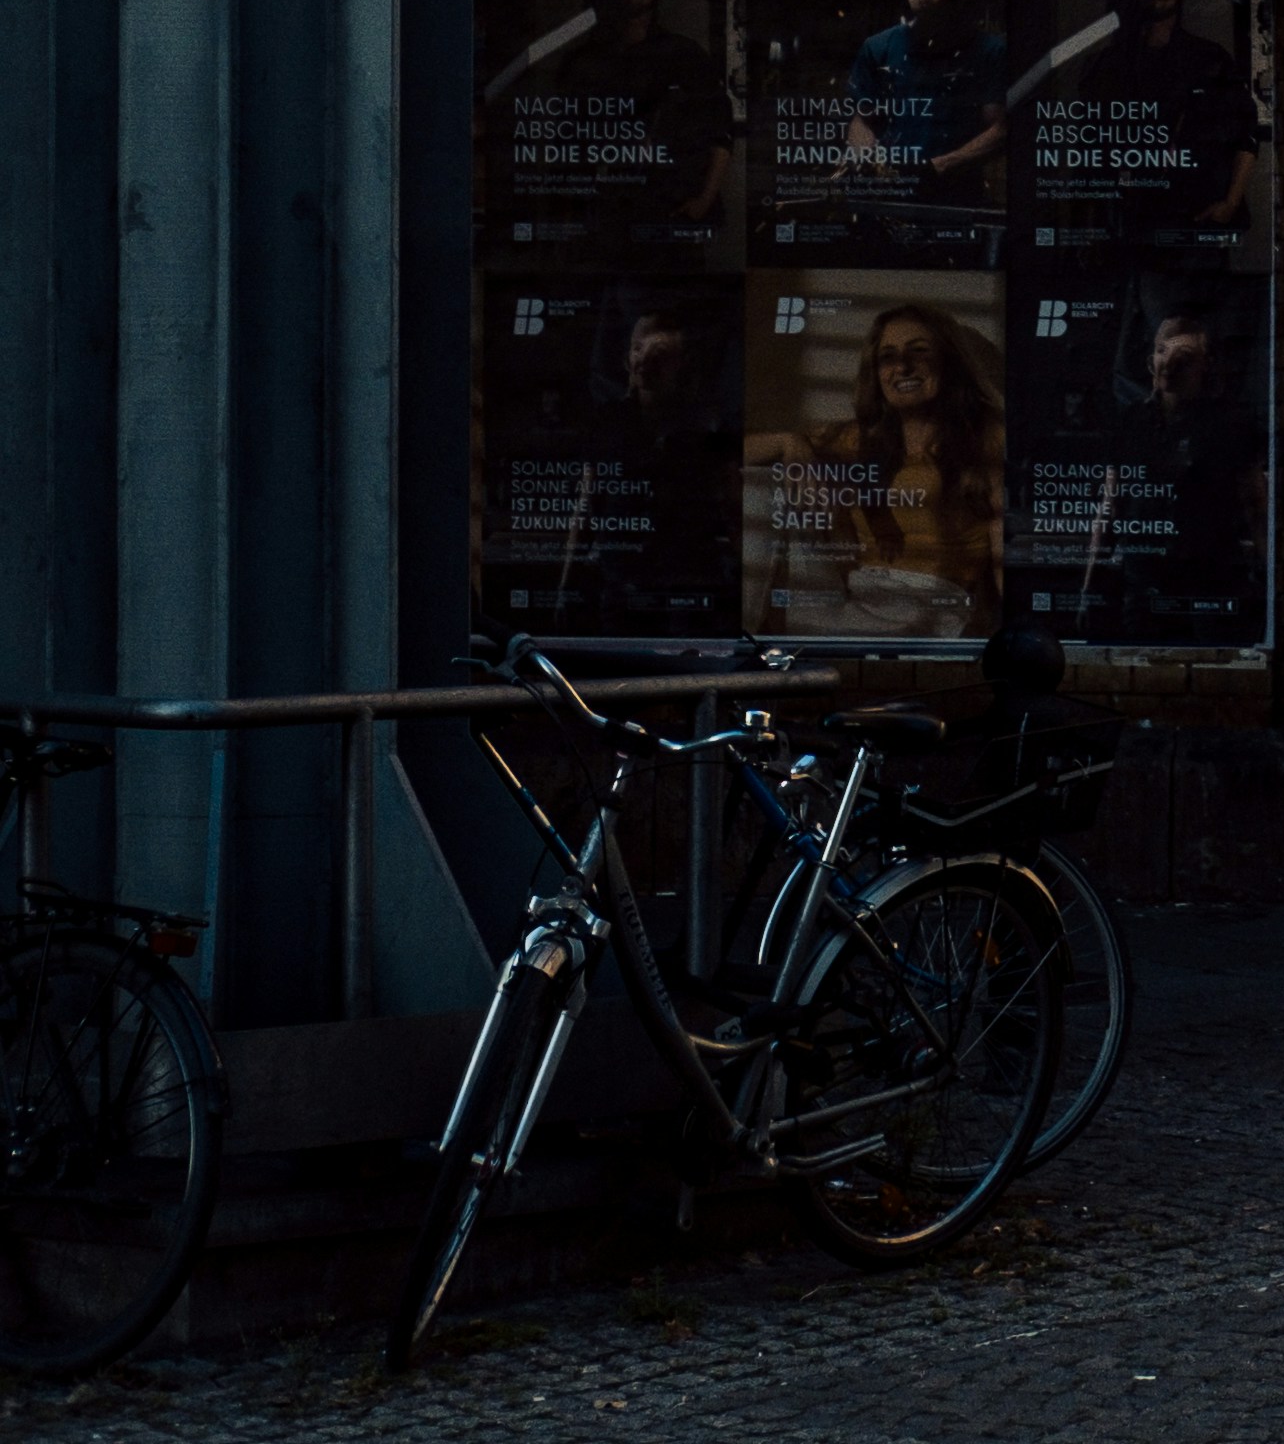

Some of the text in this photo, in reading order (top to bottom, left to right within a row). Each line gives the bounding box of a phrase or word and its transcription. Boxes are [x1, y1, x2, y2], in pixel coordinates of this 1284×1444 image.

[513, 97, 635, 116] NACH DEM
[776, 97, 934, 117] KLIMASCHUTZ
[1035, 101, 1159, 120] NACH DEM
[513, 120, 647, 140] ABSCHLUSS
[776, 121, 849, 140] BLEIBT
[1035, 125, 1169, 144] ABSCHLUSS
[514, 145, 675, 164] IN DIE SONNE.
[776, 145, 928, 165] HANDARBEIT.
[1036, 149, 1199, 168] IN DIE SONNE.
[1117, 178, 1171, 190] Ausbildung
[510, 461, 624, 477] SOLANGE DIE
[771, 463, 879, 483] SONNIGE
[1033, 464, 1147, 479] SOLANGE DIE
[510, 480, 655, 498] SONNE AUFGEHT,
[771, 487, 927, 508] AUSSICHTEN?
[1033, 483, 1179, 501] SONNE AUFGEHT,
[511, 498, 588, 512] IST DEINE
[1033, 501, 1112, 515] IST DEINE
[511, 516, 656, 532] ZUKUNFT SICHER.
[771, 511, 833, 530] SAFE!
[1033, 519, 1180, 535] ZUKUNFT SICHER.
